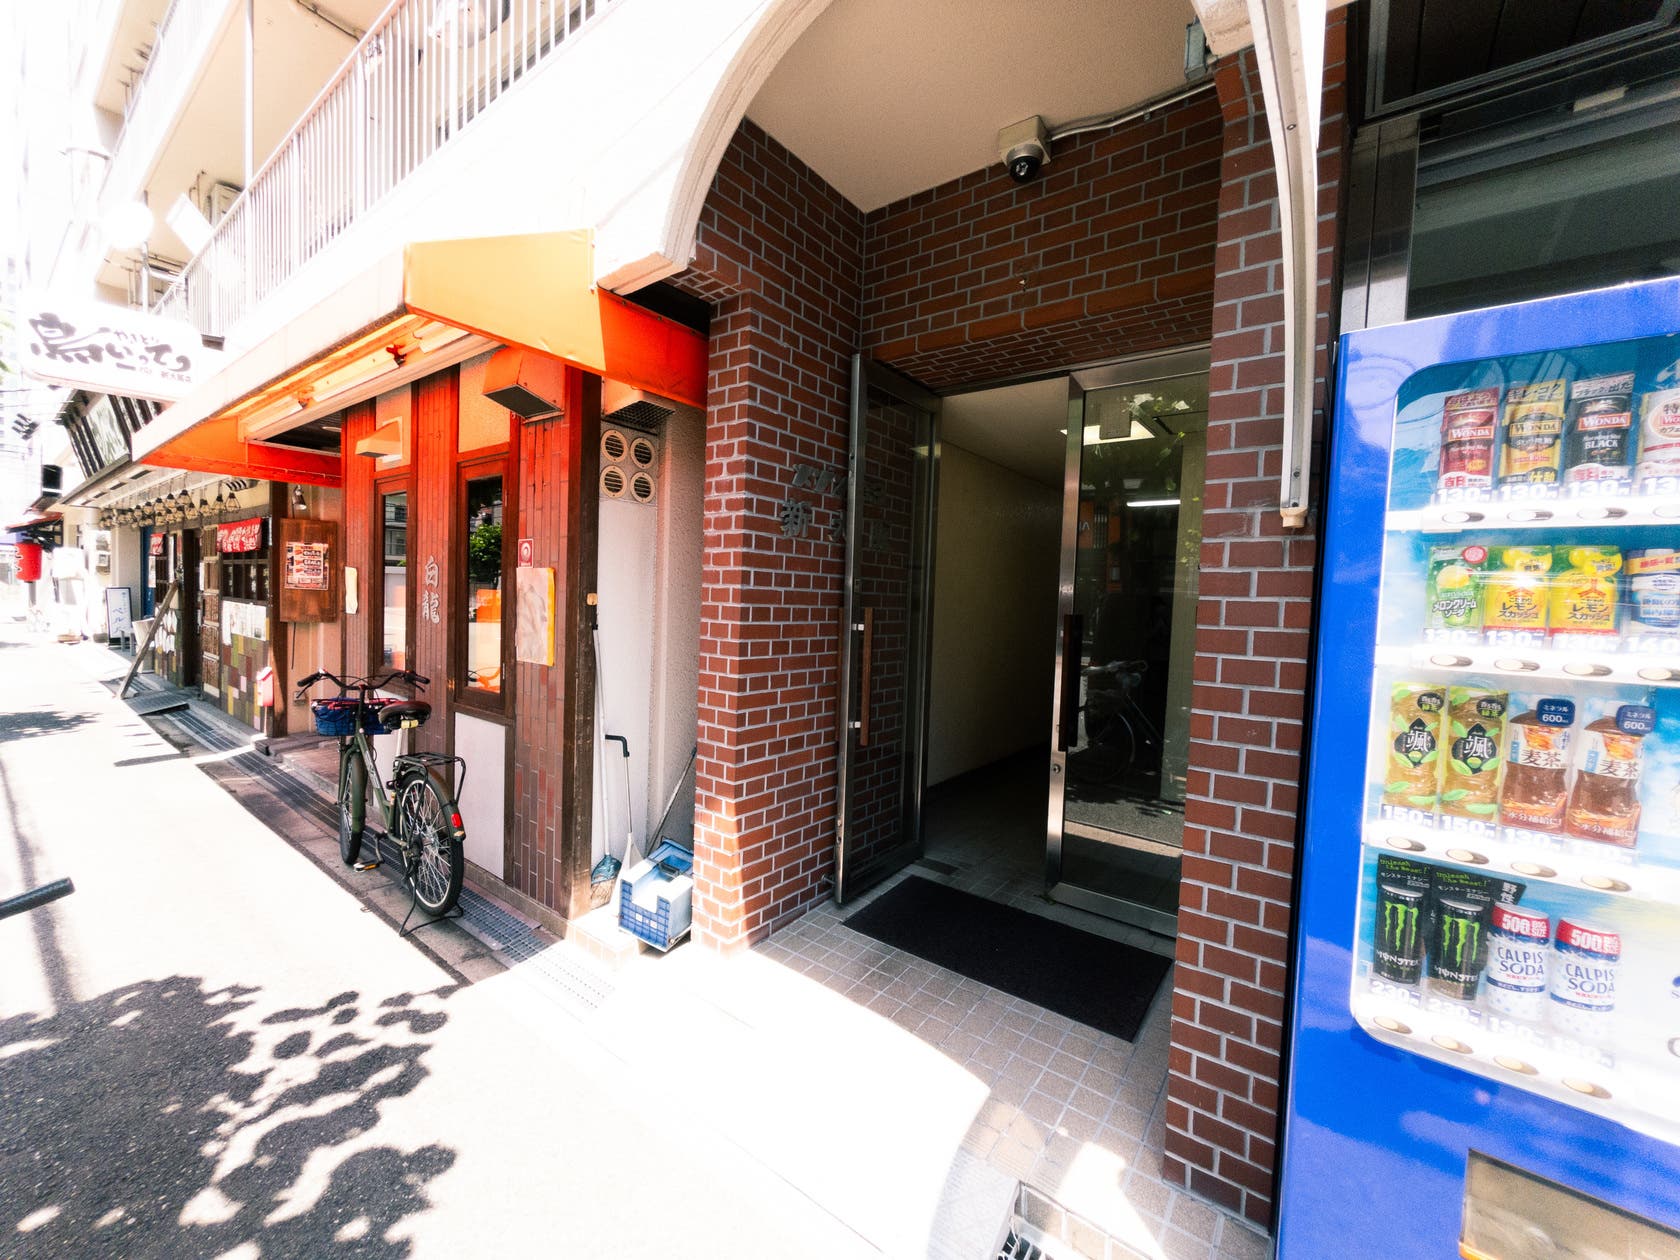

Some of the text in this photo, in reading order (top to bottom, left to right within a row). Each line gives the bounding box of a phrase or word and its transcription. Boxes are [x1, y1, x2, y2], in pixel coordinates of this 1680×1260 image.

[1515, 422, 1557, 433] WONDA
[1583, 415, 1626, 426] WONDA
[1452, 428, 1490, 438] WONDA
[1585, 440, 1618, 449] BLACK
[1432, 599, 1477, 613] メロンクリーム
[1502, 603, 1537, 611] レモン
[1572, 603, 1608, 613] レモン
[1498, 611, 1539, 619] スカッシュ
[1568, 612, 1610, 621] スカッシュ
[1406, 730, 1429, 752] 颯
[1464, 736, 1490, 759] 颯
[1521, 749, 1561, 768] 麦茶
[1600, 758, 1639, 778] 麦茶
[1498, 947, 1544, 964] CALPIS
[1499, 961, 1545, 976] SODA
[1566, 963, 1615, 981] CALPIS
[1568, 977, 1615, 995] SODA
